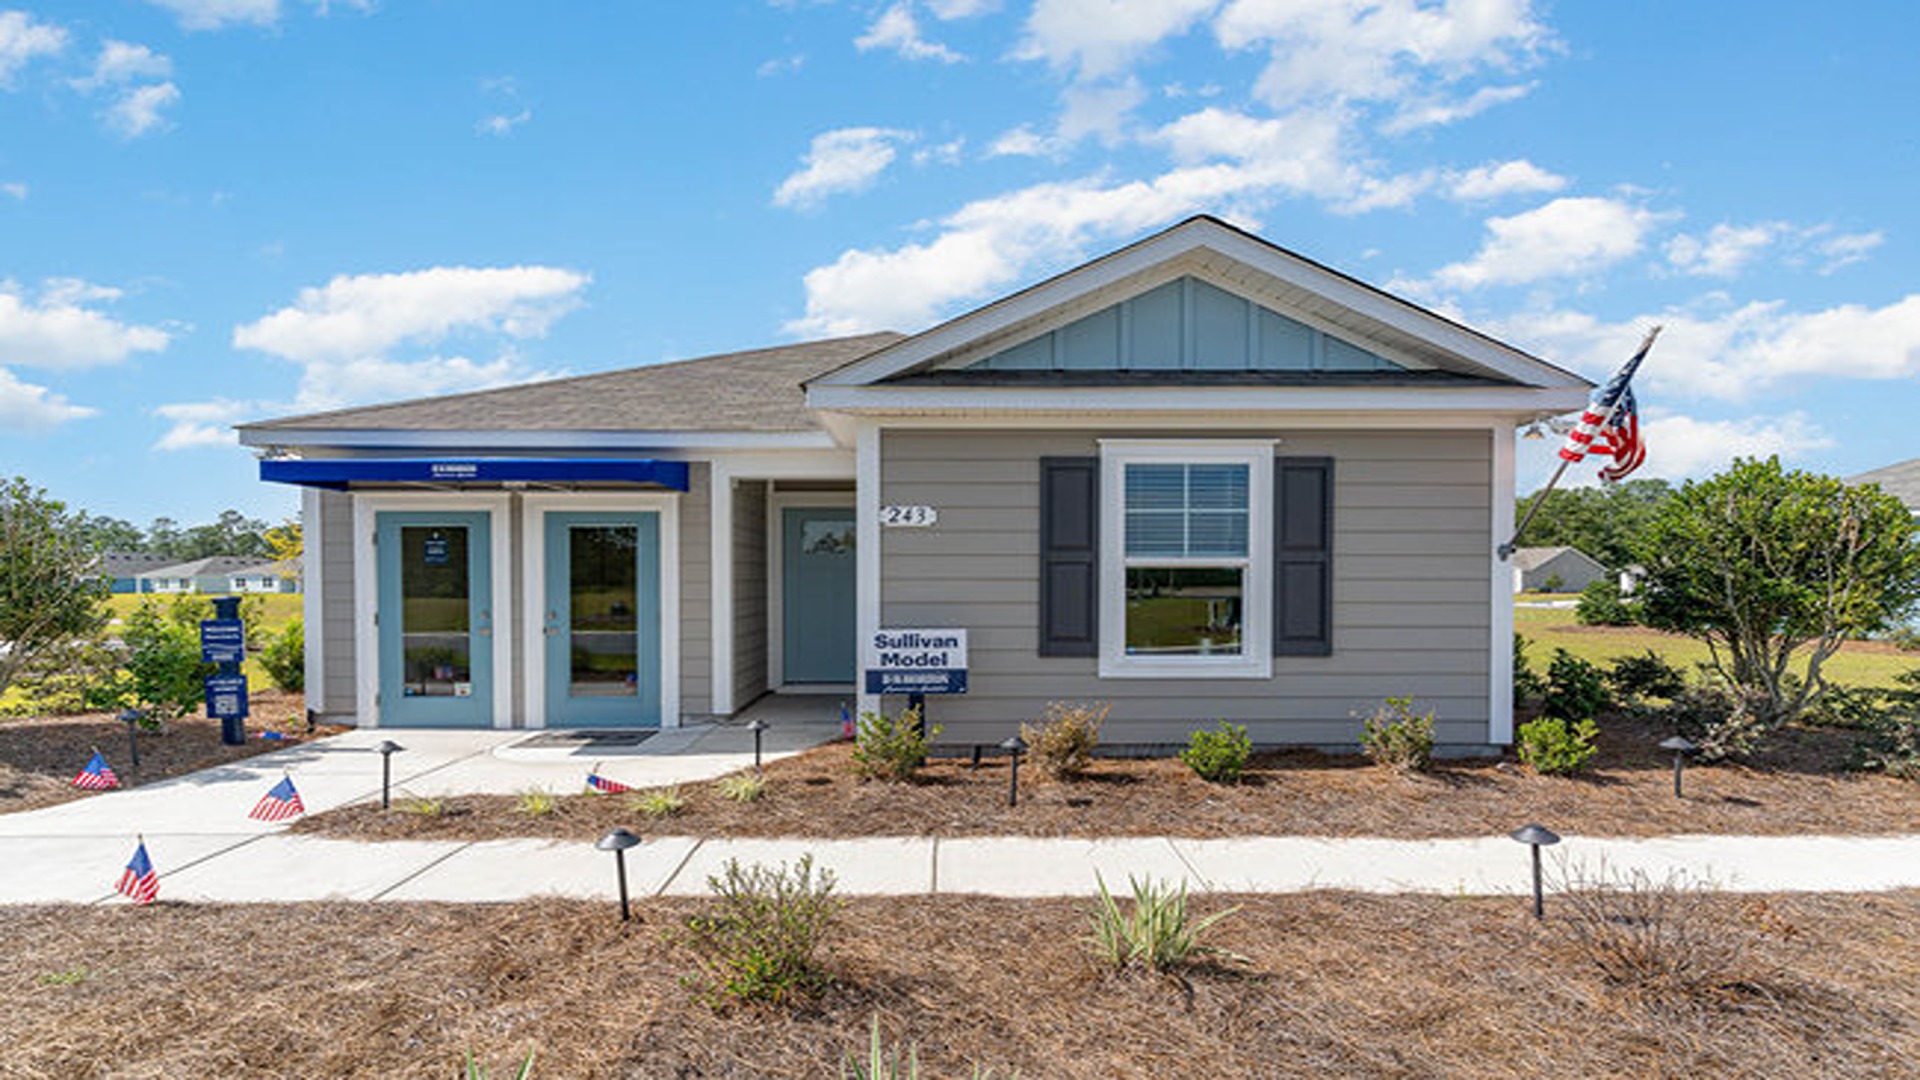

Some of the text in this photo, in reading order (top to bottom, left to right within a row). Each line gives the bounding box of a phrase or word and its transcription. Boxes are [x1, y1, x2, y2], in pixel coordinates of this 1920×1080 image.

[888, 506, 926, 524] 243
[874, 633, 958, 649] Sullivan
[881, 652, 948, 667] Model
